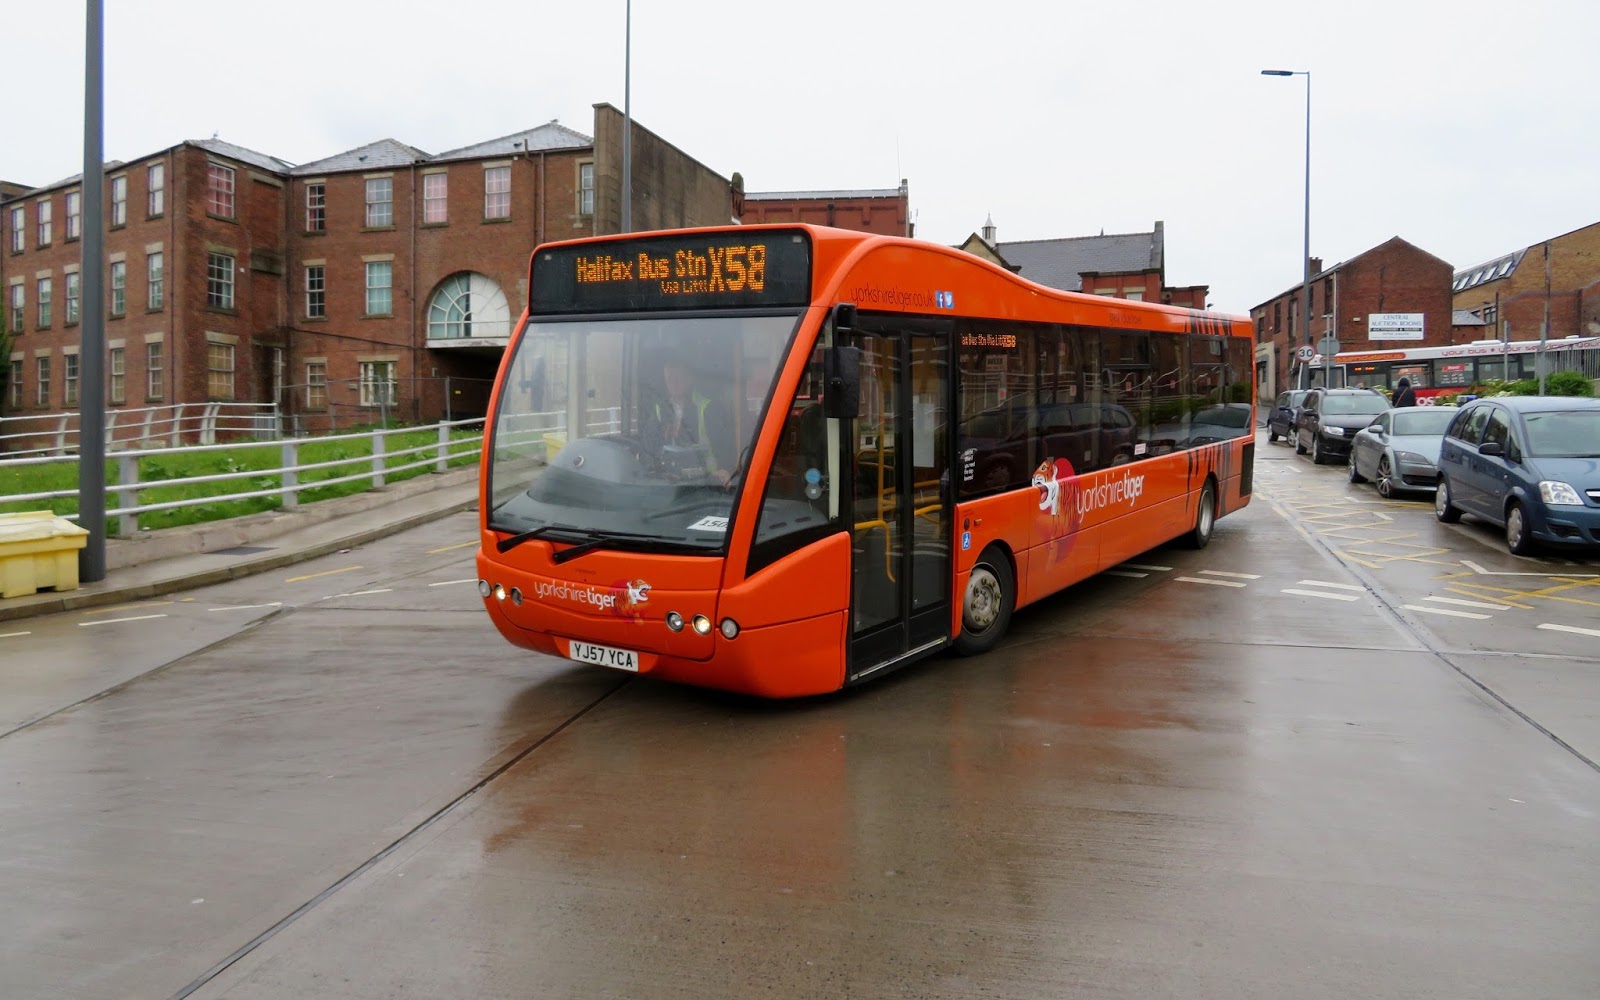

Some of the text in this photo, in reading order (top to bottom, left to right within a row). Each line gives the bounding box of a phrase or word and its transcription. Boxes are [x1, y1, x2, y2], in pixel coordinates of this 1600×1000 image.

[577, 244, 767, 293] Halifax Bus Stn X58
[850, 283, 934, 311] yorkshiretiger.co.uk
[1299, 348, 1313, 358] 30
[1077, 468, 1145, 523] yorkshiretiger
[534, 580, 617, 610] yorkshiretiger
[574, 642, 633, 668] YJ57 YCA
